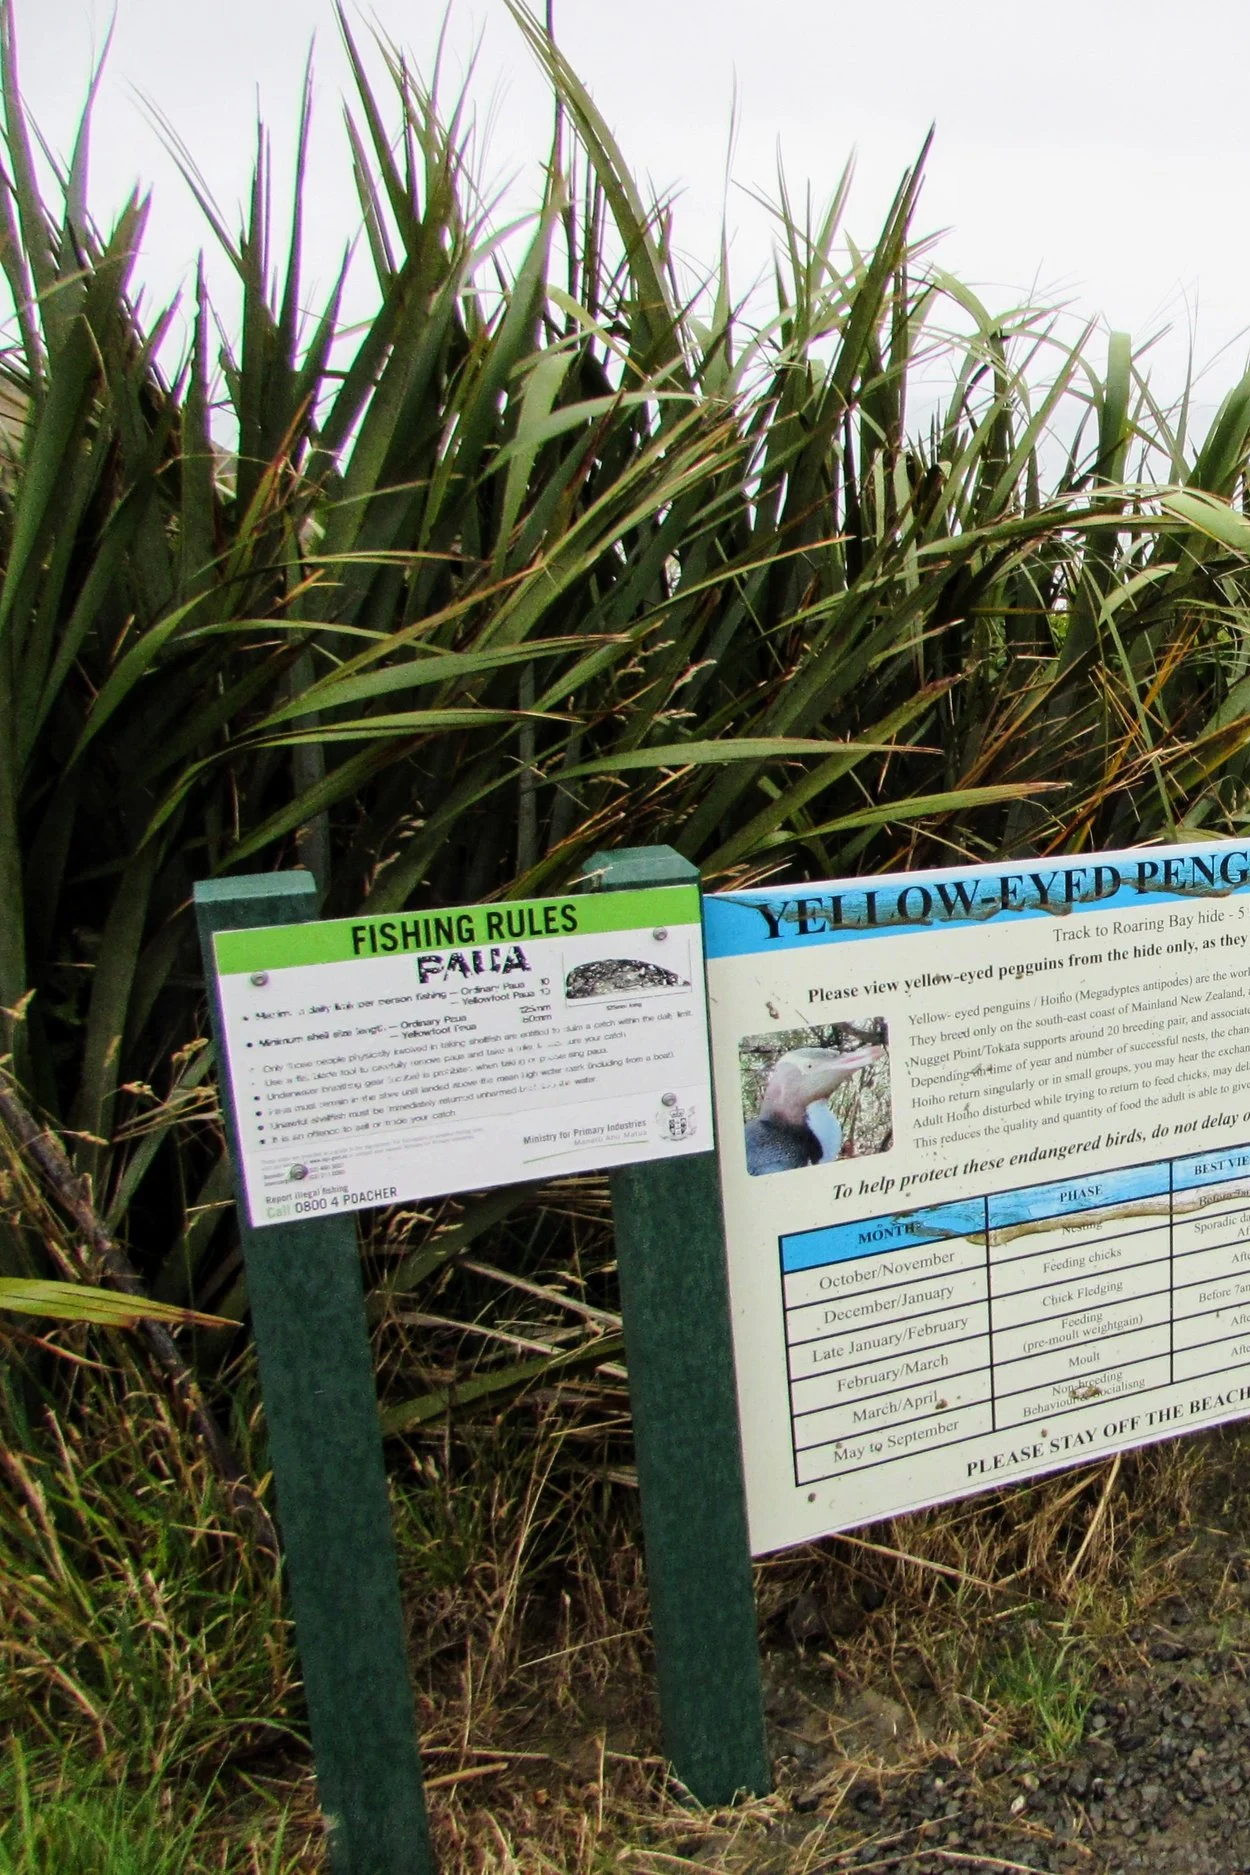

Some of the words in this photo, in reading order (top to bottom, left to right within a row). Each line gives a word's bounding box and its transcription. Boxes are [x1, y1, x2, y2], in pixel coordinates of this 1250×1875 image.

[757, 865, 1120, 939] YELLOW-EYED
[351, 913, 476, 955] FISHING
[485, 902, 578, 941] RULES
[1052, 925, 1090, 942] Track
[1095, 926, 1108, 936] to
[1113, 917, 1164, 934] Roaring
[1169, 914, 1193, 929] Bay
[1198, 909, 1224, 924] hide
[1237, 906, 1244, 919] 5
[808, 986, 858, 1003] Please
[863, 980, 899, 995] view
[903, 964, 993, 993] yellow-eyed
[998, 956, 1063, 980] penguins
[1068, 953, 1102, 967] from
[1107, 948, 1128, 961] the
[1133, 943, 1162, 958] hide
[1166, 938, 1198, 954] only,
[1202, 938, 1215, 949] as
[1220, 933, 1247, 947] they
[954, 1005, 979, 1020] eyed
[983, 1000, 1030, 1017] penguins
[1075, 984, 1139, 1002] (Megadyptes
[1142, 975, 1192, 991] antipodes)
[1195, 975, 1209, 983] are
[1212, 971, 1226, 981] the
[522, 1131, 557, 1146] Ministry
[558, 1128, 571, 1139] for
[572, 1123, 604, 1138] Primary
[606, 1116, 647, 1132] Industries
[832, 1183, 852, 1200] To
[858, 1175, 895, 1195] help
[899, 1164, 958, 1190] protect
[962, 1157, 1004, 1175] these
[1009, 1134, 1101, 1165] endangered
[1104, 1128, 1146, 1147] birds,
[1151, 1123, 1169, 1139] do
[1173, 1119, 1197, 1134] not
[1201, 1112, 1239, 1129] delay
[1194, 1159, 1226, 1176] BEST
[264, 1192, 293, 1206] Report
[294, 1187, 321, 1201] illegal
[321, 1182, 349, 1196] fishing
[294, 1197, 328, 1214] 0800
[329, 1195, 340, 1208] 4
[342, 1185, 398, 1206] POACHER
[1057, 1184, 1102, 1203] PHASE
[1194, 1216, 1236, 1234] Sporadic
[819, 1252, 954, 1289] October/November
[1043, 1257, 1085, 1273] Feeding
[1088, 1248, 1121, 1262] chicks
[823, 1286, 953, 1324] December/January
[1042, 1290, 1073, 1306] Chick
[1077, 1281, 1122, 1298] Fledging
[1198, 1289, 1230, 1302] Before
[1022, 1329, 1078, 1353] (pre-moult
[1082, 1314, 1143, 1336] weightgain)
[1061, 1312, 1102, 1328] Feeding
[812, 1347, 843, 1362] Late
[848, 1317, 967, 1354] January/February
[837, 1353, 948, 1392] February/March
[1068, 1351, 1099, 1367] Moult
[853, 1389, 939, 1423] March/April
[833, 1443, 864, 1462] May
[868, 1437, 883, 1454] to
[887, 1420, 959, 1448] September
[966, 1442, 1044, 1477] PLEASE
[1049, 1427, 1097, 1453] STAY
[1102, 1415, 1140, 1437] OFF
[1144, 1403, 1183, 1425] THE
[1189, 1385, 1250, 1415] BEACH
